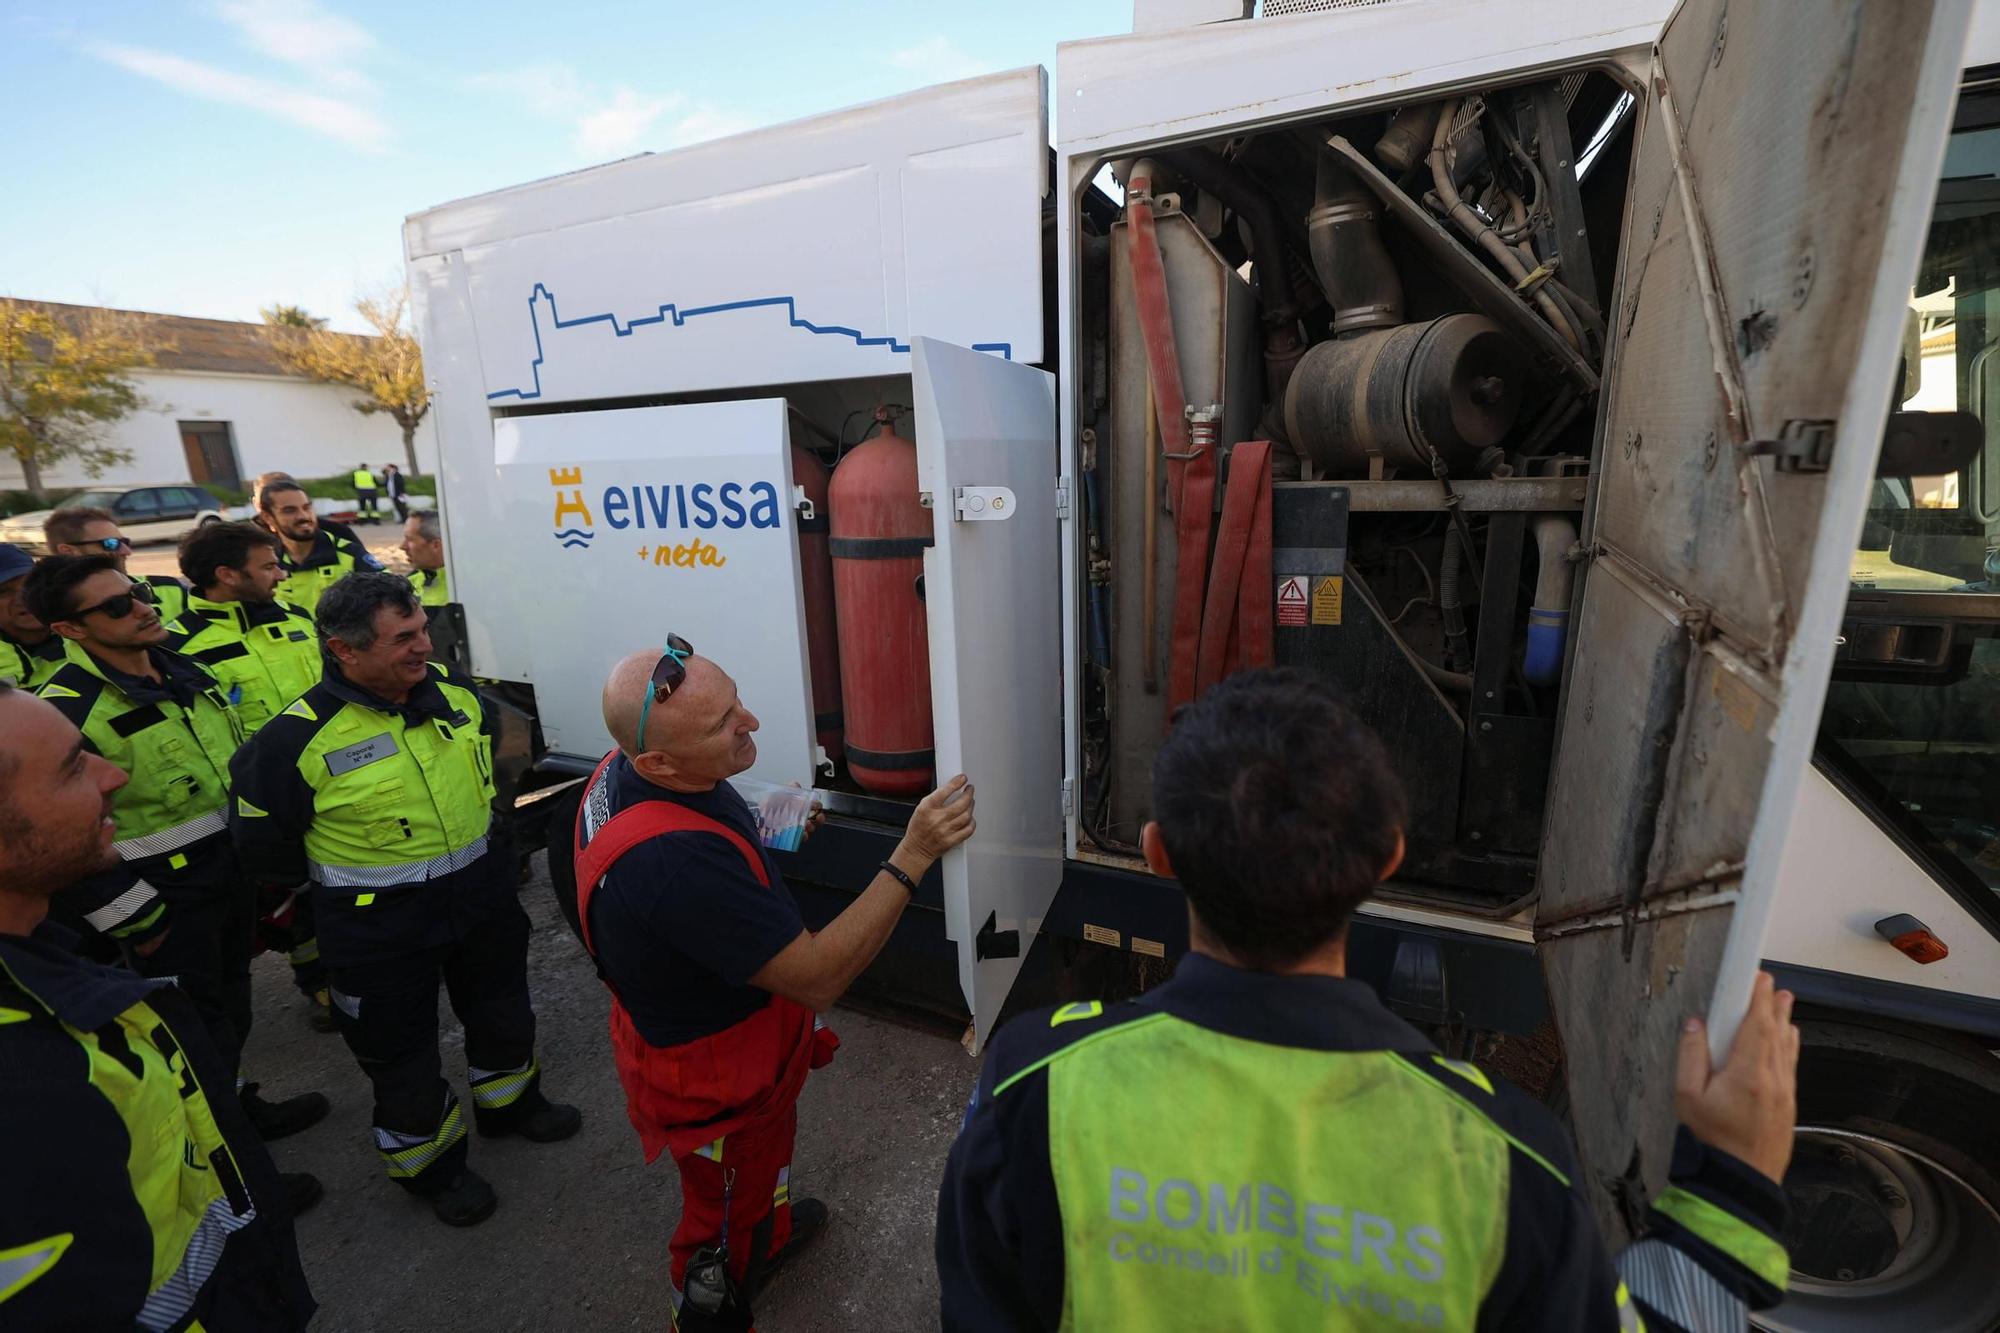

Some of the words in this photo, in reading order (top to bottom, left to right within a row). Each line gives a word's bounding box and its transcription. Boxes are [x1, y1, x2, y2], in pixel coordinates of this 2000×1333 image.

[654, 537, 727, 568] neta
[345, 744, 376, 758] Caporal
[1110, 1166, 1445, 1284] BOMBERS
[1108, 1231, 1249, 1279] Consell
